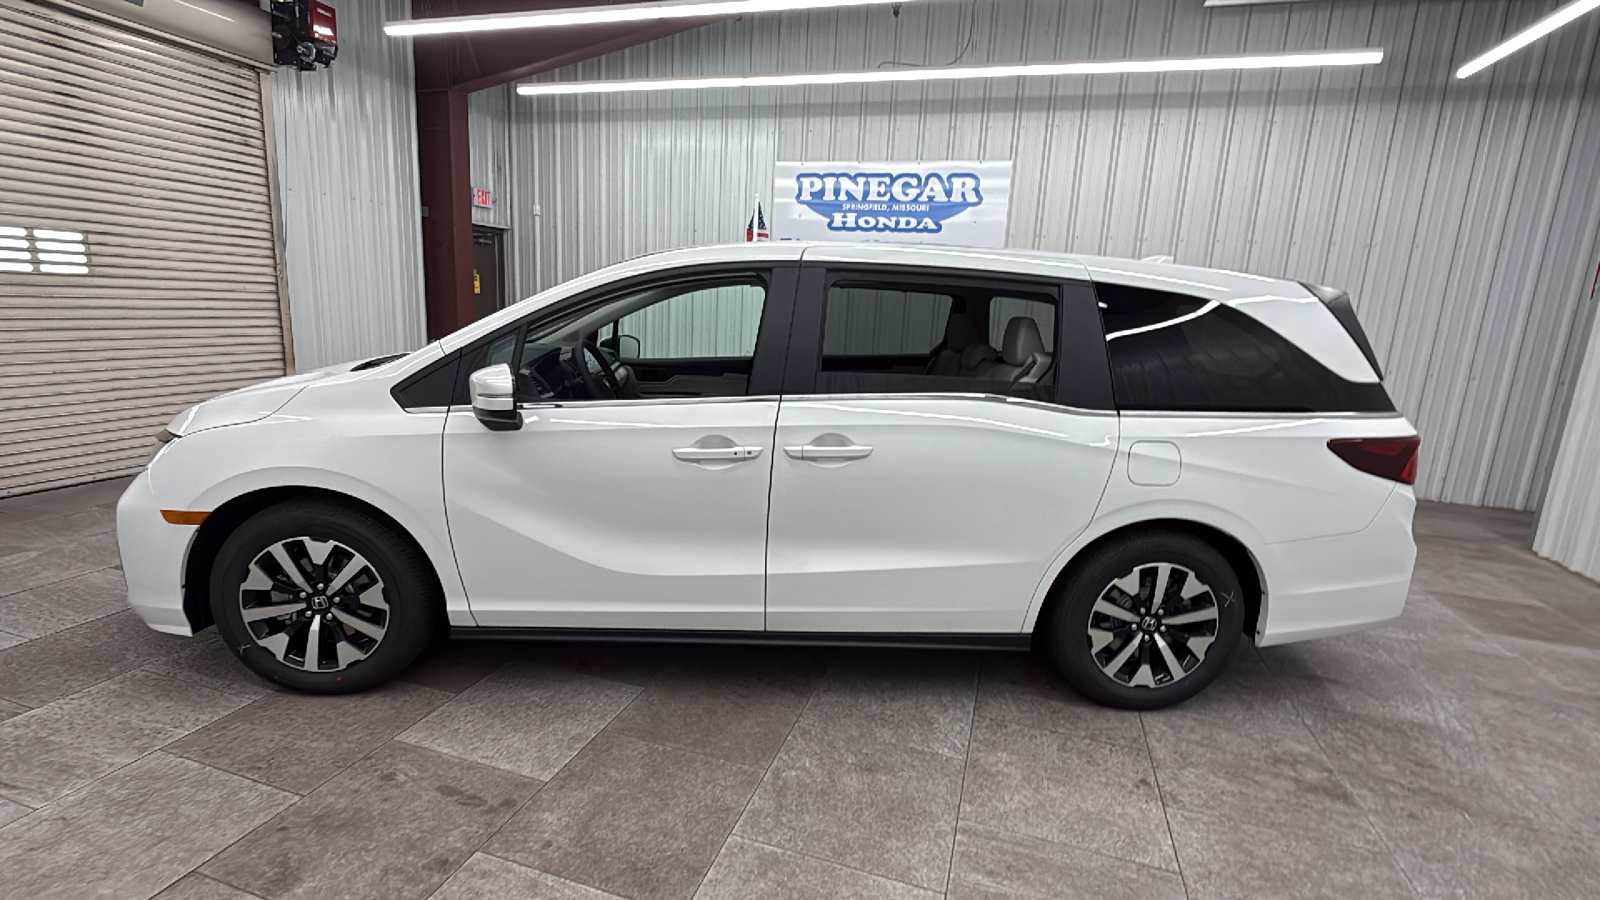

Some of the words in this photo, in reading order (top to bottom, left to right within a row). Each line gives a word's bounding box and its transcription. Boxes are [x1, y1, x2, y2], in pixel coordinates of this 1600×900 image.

[476, 188, 491, 206] EXIT
[799, 175, 980, 203] PINEGAR
[842, 203, 890, 212] SPRINGFIELD,
[892, 203, 929, 212] MISSOURI
[831, 212, 938, 229] HONDA
